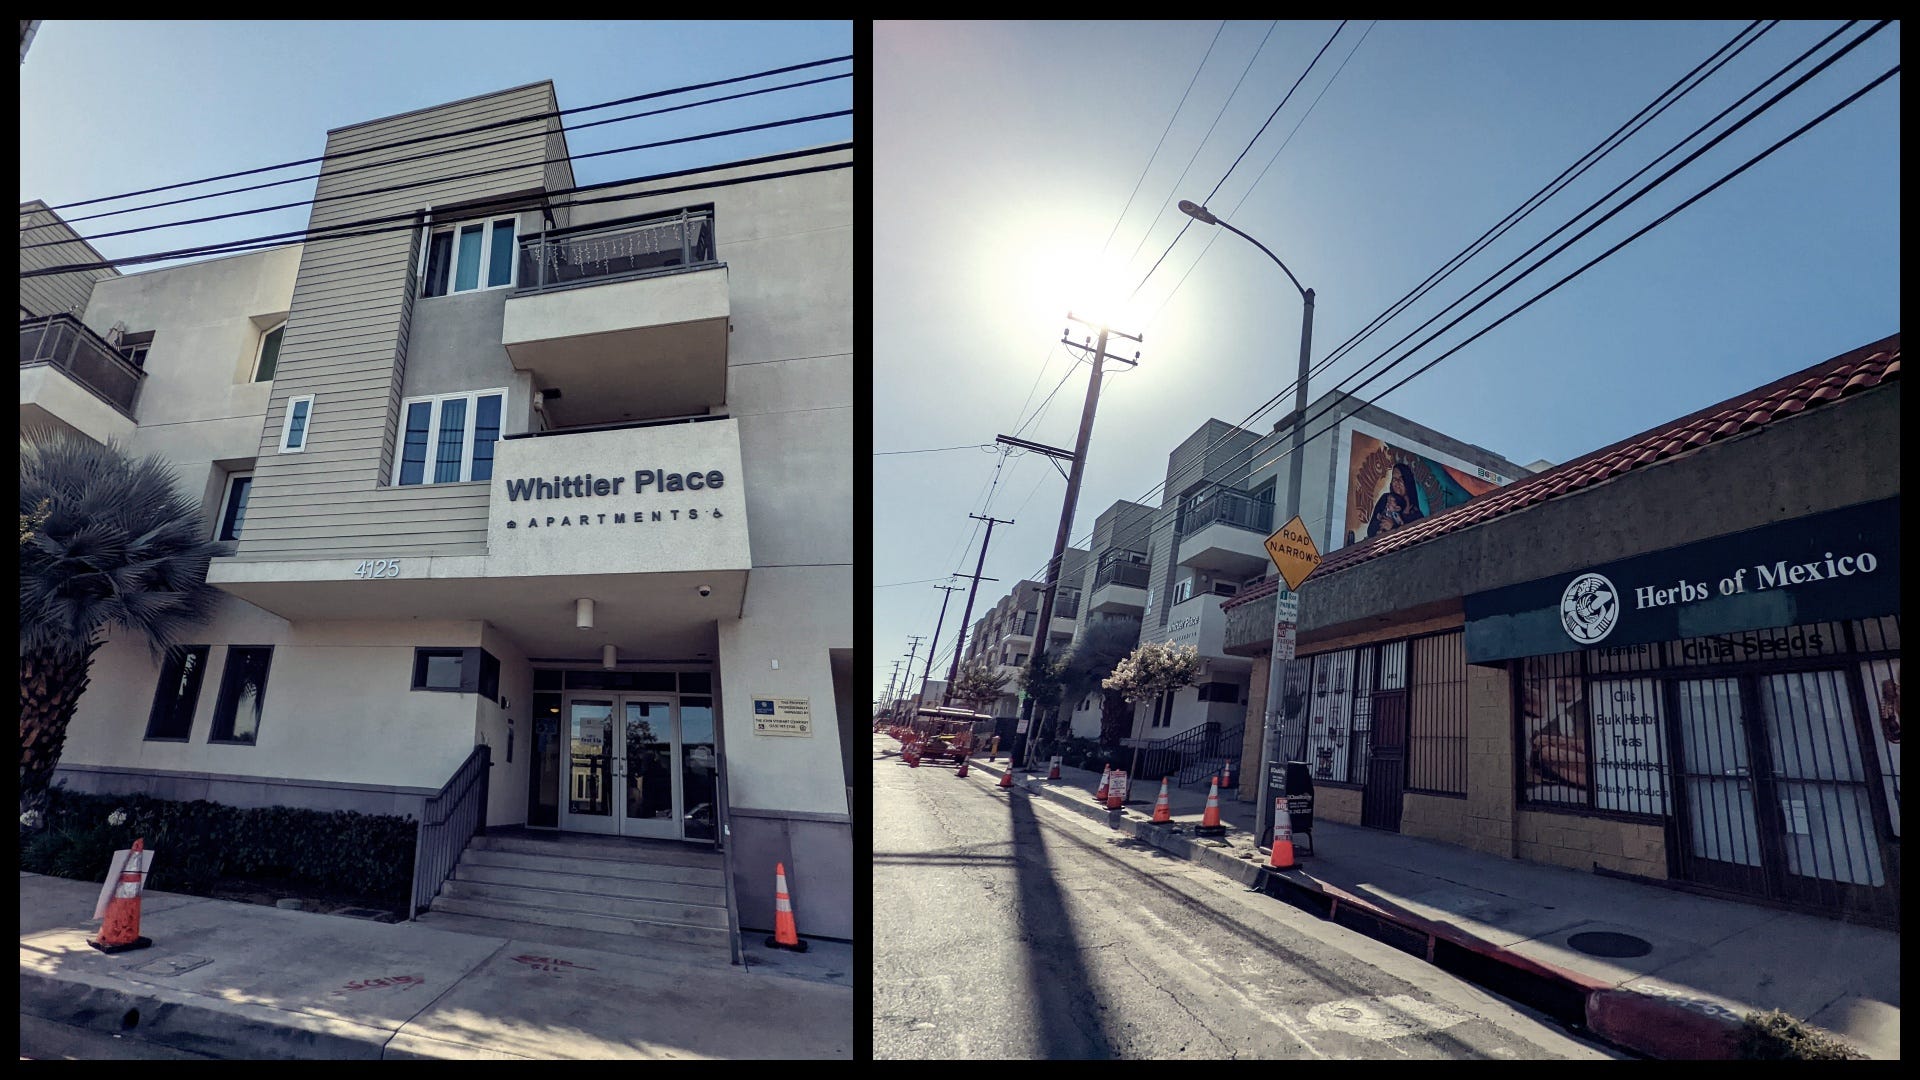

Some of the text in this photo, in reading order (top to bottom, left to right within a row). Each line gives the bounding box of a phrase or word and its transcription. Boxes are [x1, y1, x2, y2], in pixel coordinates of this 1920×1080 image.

[506, 469, 725, 502] Whittier Place
[528, 509, 699, 528] APARTMENTS
[1283, 529, 1310, 546] ROAD
[1270, 541, 1319, 565] NARROWS
[354, 559, 401, 579] 4125
[1634, 552, 1878, 610] Herbs of Mexico
[1685, 632, 1824, 661] Chia Seeds
[1596, 713, 1622, 726] Buk
[1614, 735, 1643, 748] Teas
[1600, 757, 1661, 773] Probiotics
[1628, 785, 1670, 798] Producs
